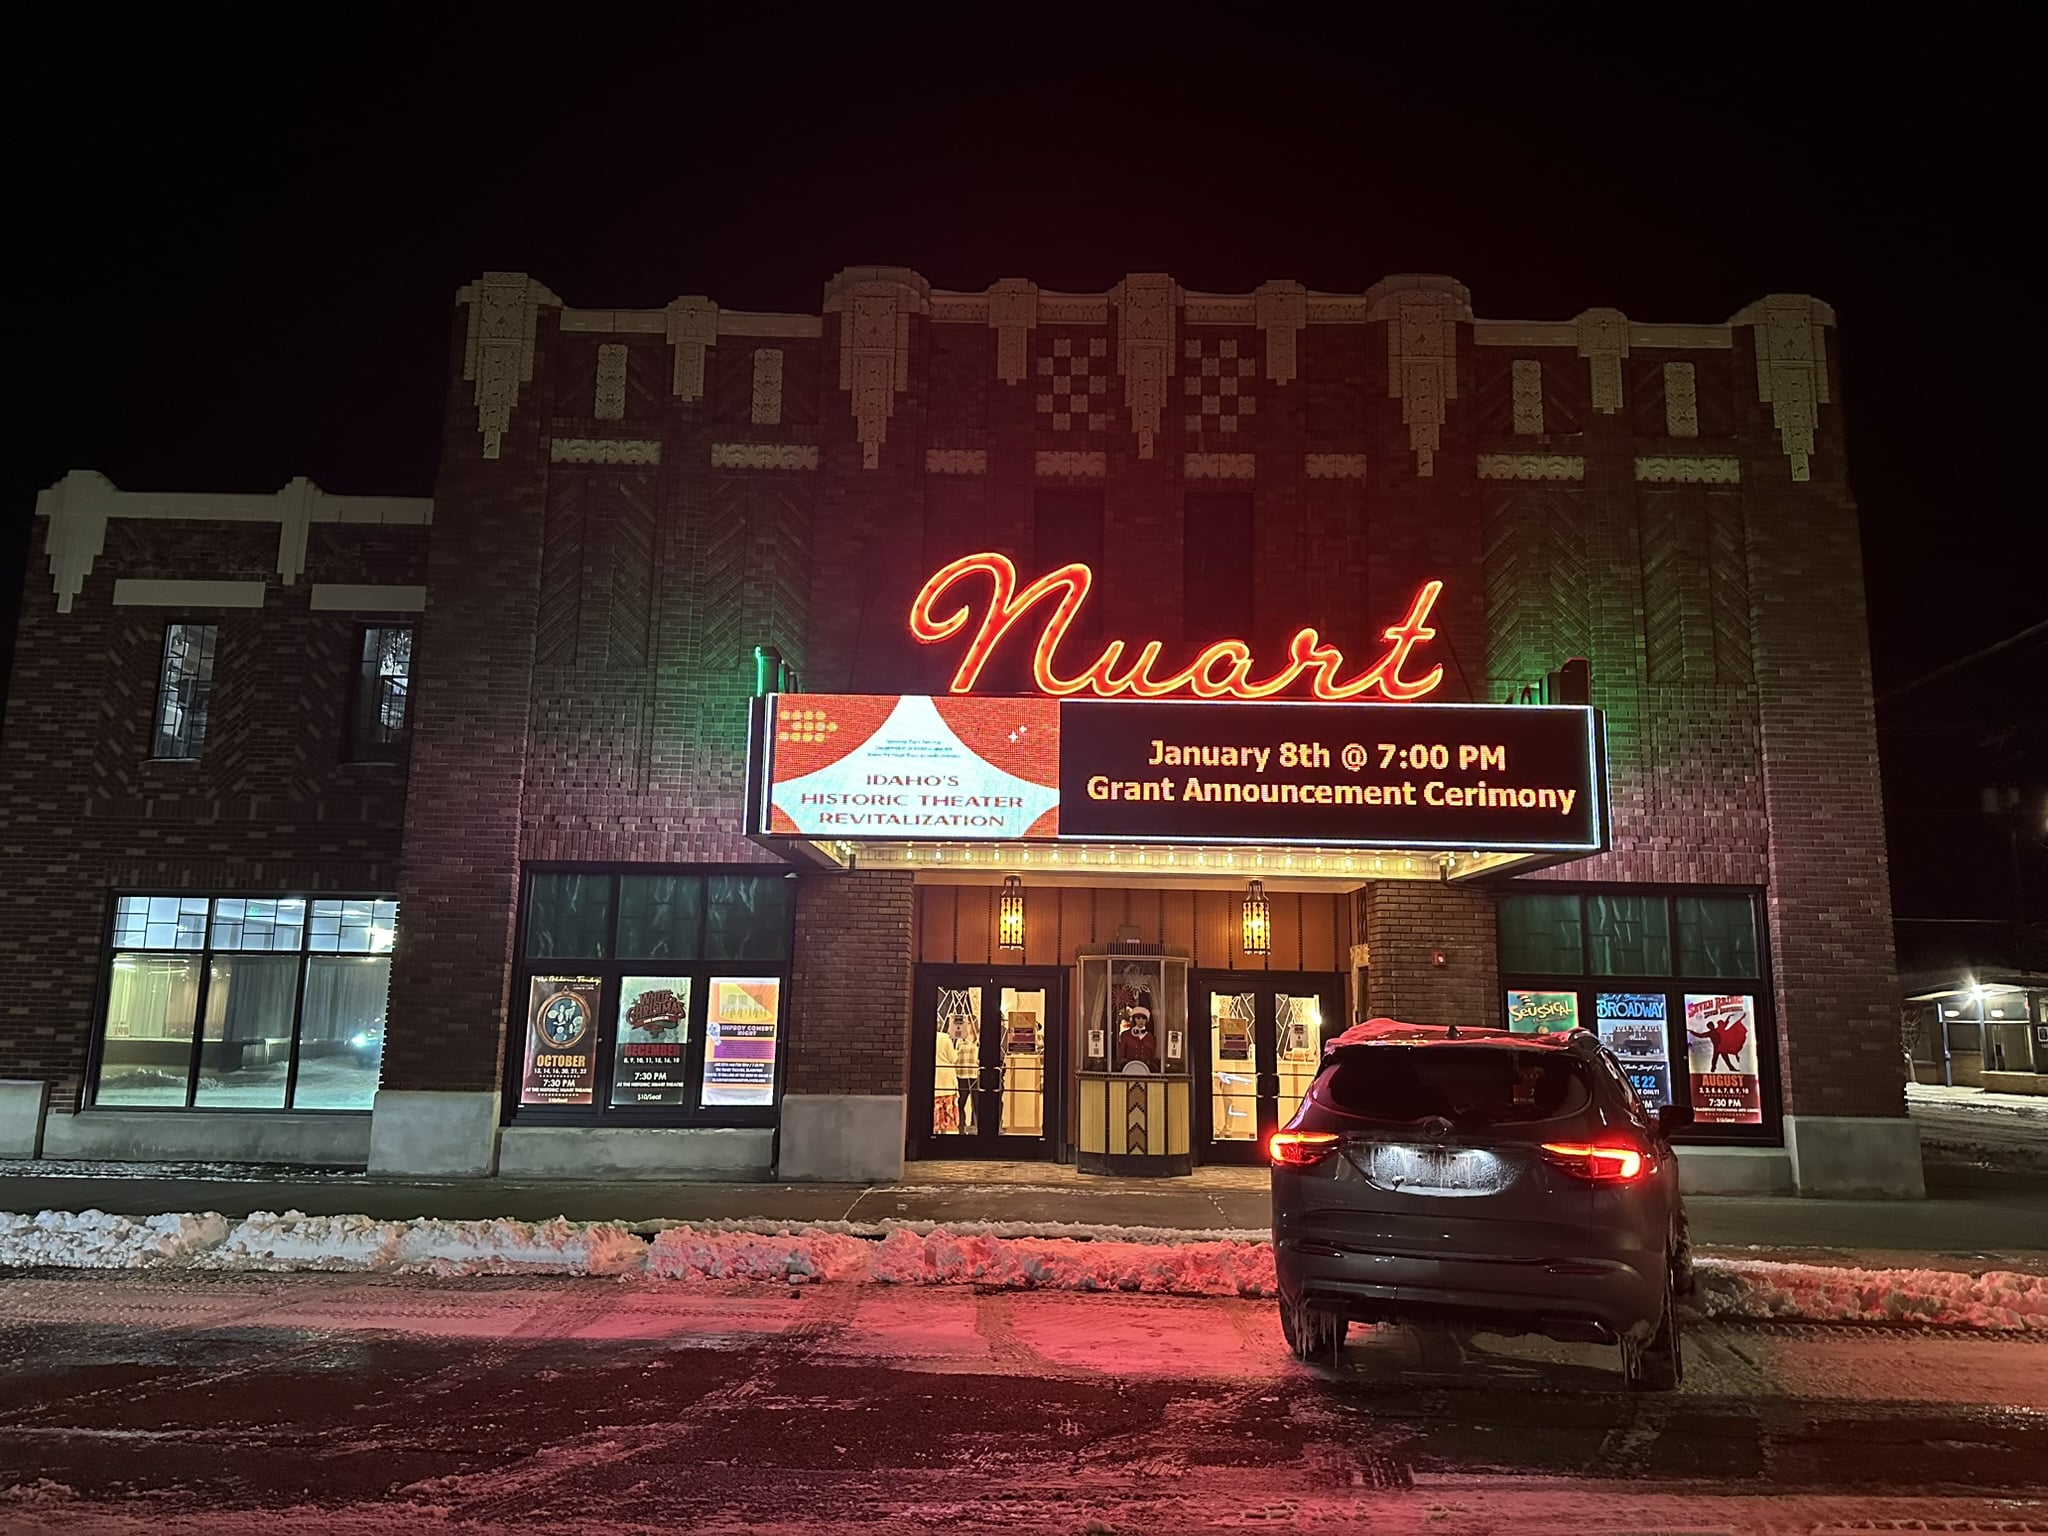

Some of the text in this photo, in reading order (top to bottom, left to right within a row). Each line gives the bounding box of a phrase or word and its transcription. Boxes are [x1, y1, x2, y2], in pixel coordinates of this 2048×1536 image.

[909, 552, 1443, 699] Nuart
[1148, 740, 1506, 772] January 8th @ 7:00 PM
[866, 774, 960, 787] IDAHO'S
[800, 792, 1023, 808] HISTORIC THEATER
[1087, 776, 1576, 815] Grant Announcement Cerimony
[819, 812, 1005, 827] REVITALIZATION
[639, 991, 671, 1004] WHITE
[626, 1001, 686, 1024] CHRISTMAS
[1596, 1000, 1664, 1018] BROADWAY
[624, 1044, 680, 1056] DECEMBER
[536, 1054, 586, 1067] OCTOBER
[634, 1072, 652, 1080] 7:30
[1641, 1076, 1656, 1088] 22
[1702, 1075, 1744, 1087] AUGUST
[1708, 1098, 1741, 1107] 7:30 PM
